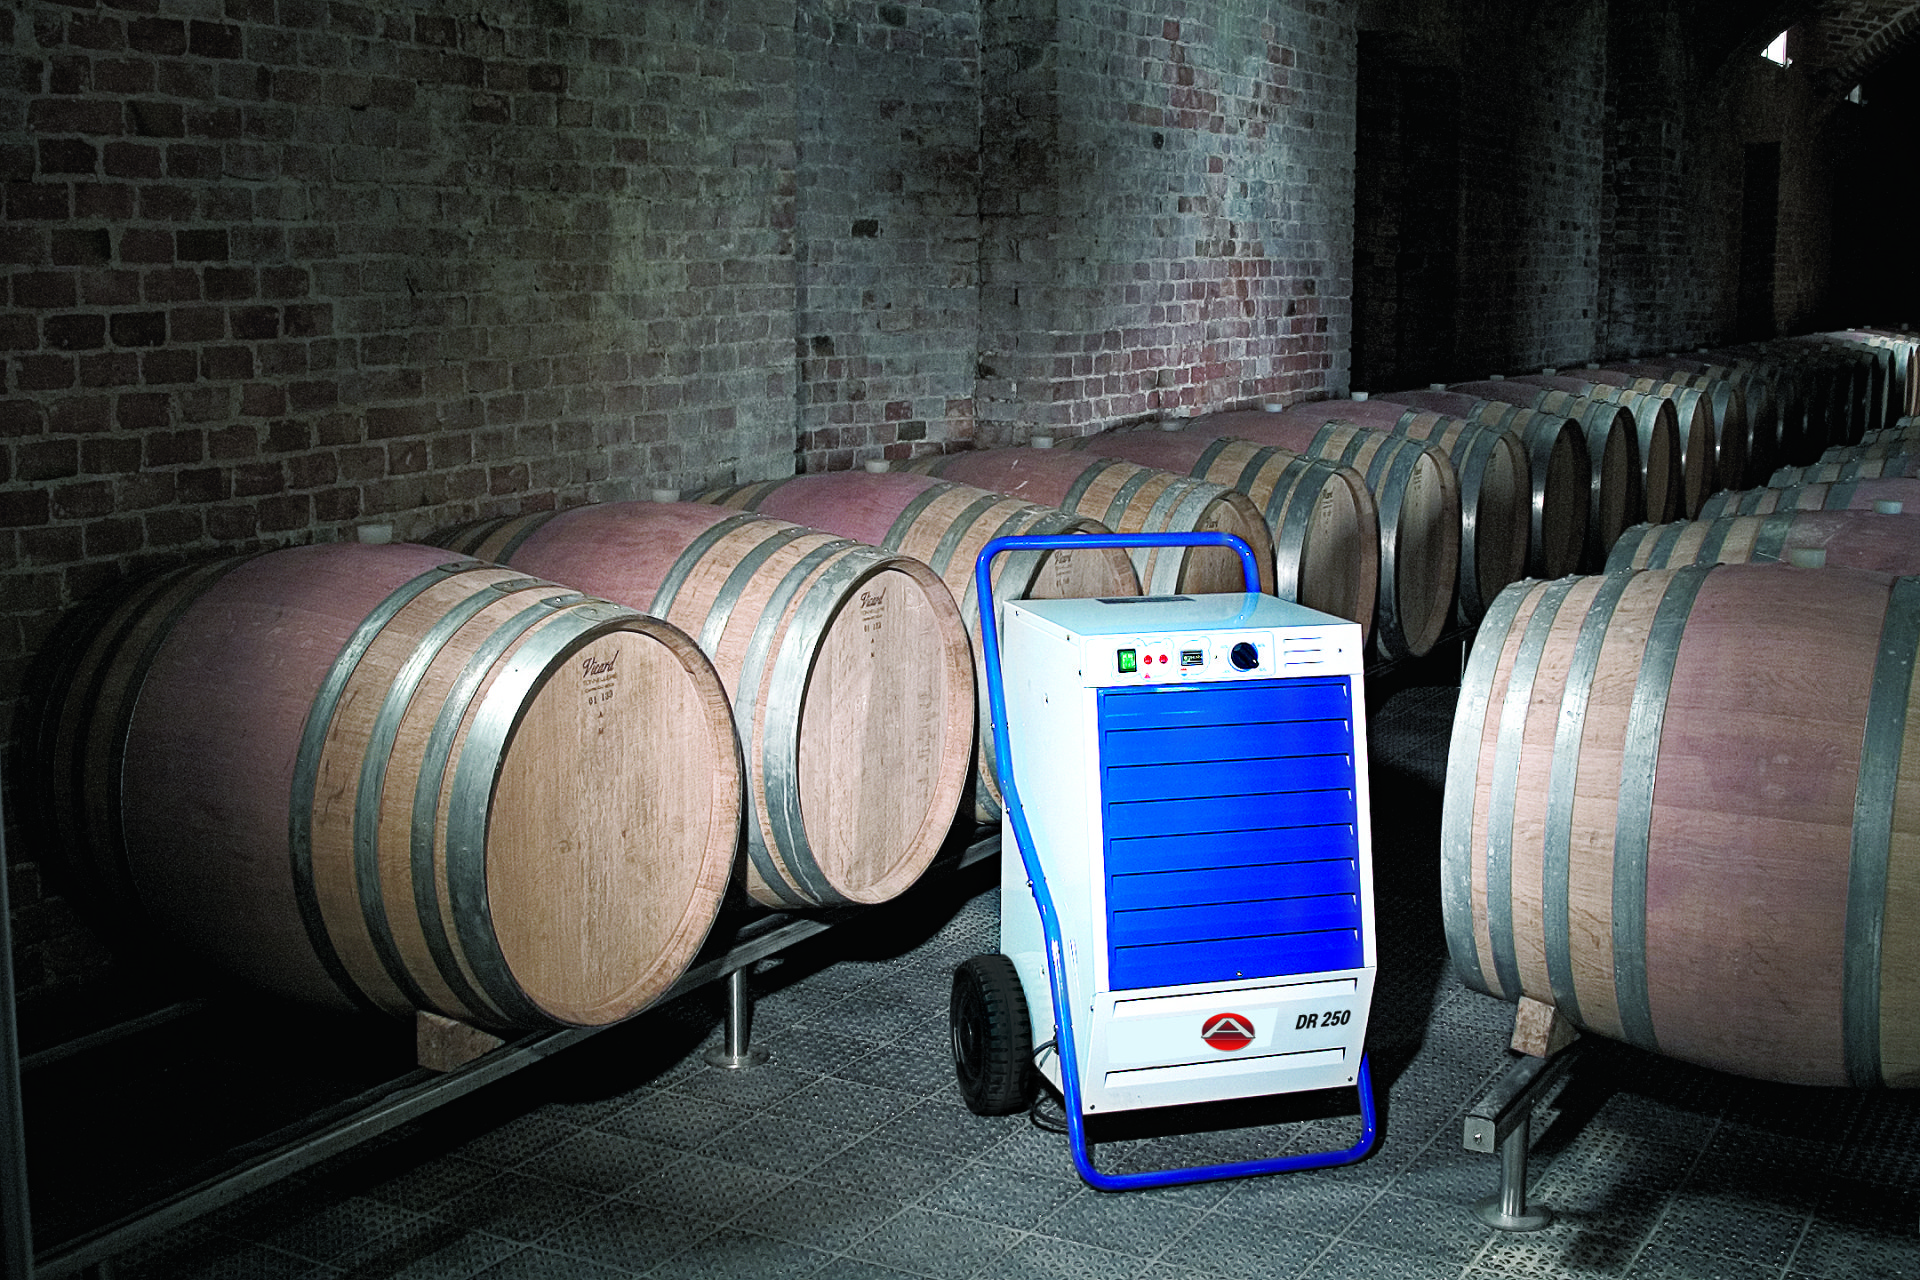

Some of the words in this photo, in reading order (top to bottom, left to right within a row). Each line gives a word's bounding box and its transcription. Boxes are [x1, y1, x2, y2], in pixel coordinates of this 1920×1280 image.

[583, 650, 619, 678] Vicard
[1295, 1013, 1319, 1030] DR
[1321, 1010, 1351, 1027] 250
